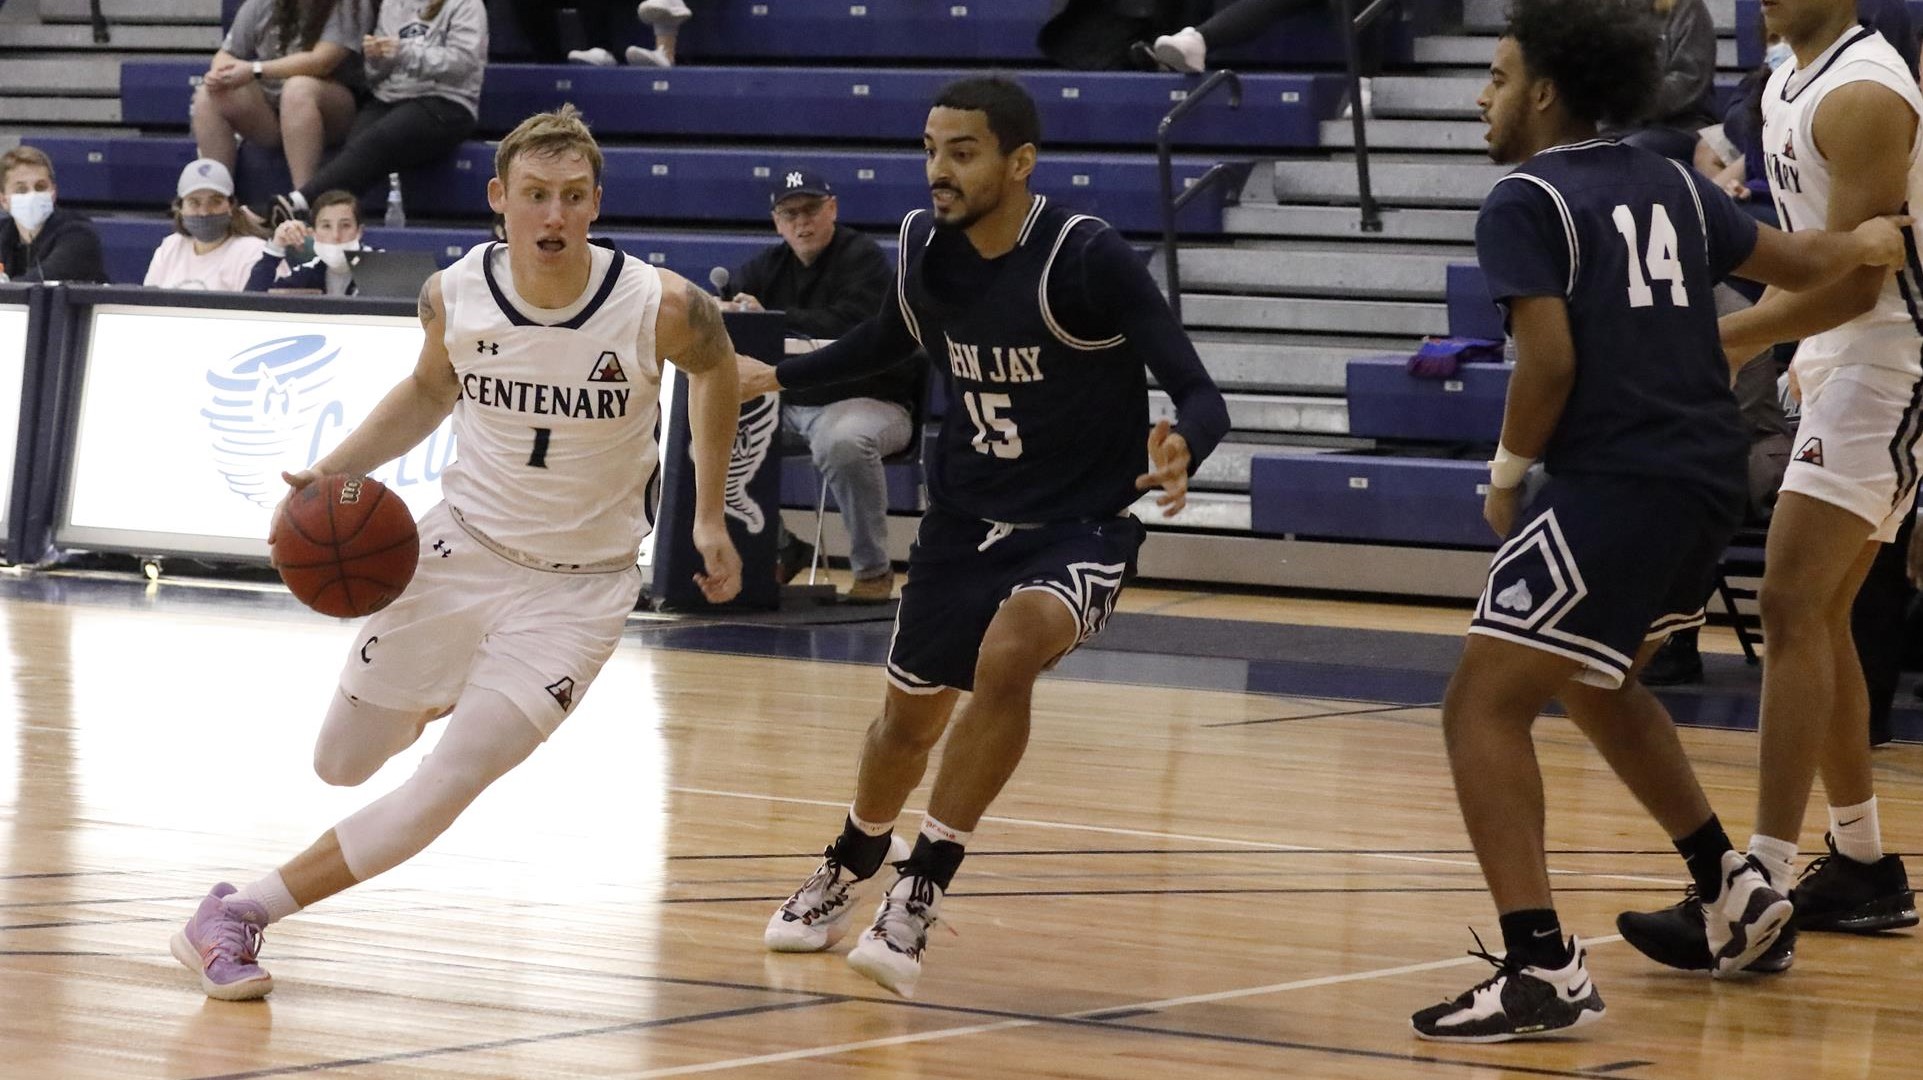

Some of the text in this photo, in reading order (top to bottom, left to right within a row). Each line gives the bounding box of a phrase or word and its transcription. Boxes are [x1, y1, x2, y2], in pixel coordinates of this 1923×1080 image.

[1611, 203, 1689, 307] 14
[989, 346, 1044, 382] JAY
[464, 373, 631, 419] CENTENARY
[526, 427, 552, 469] 1
[964, 391, 1024, 459] 15
